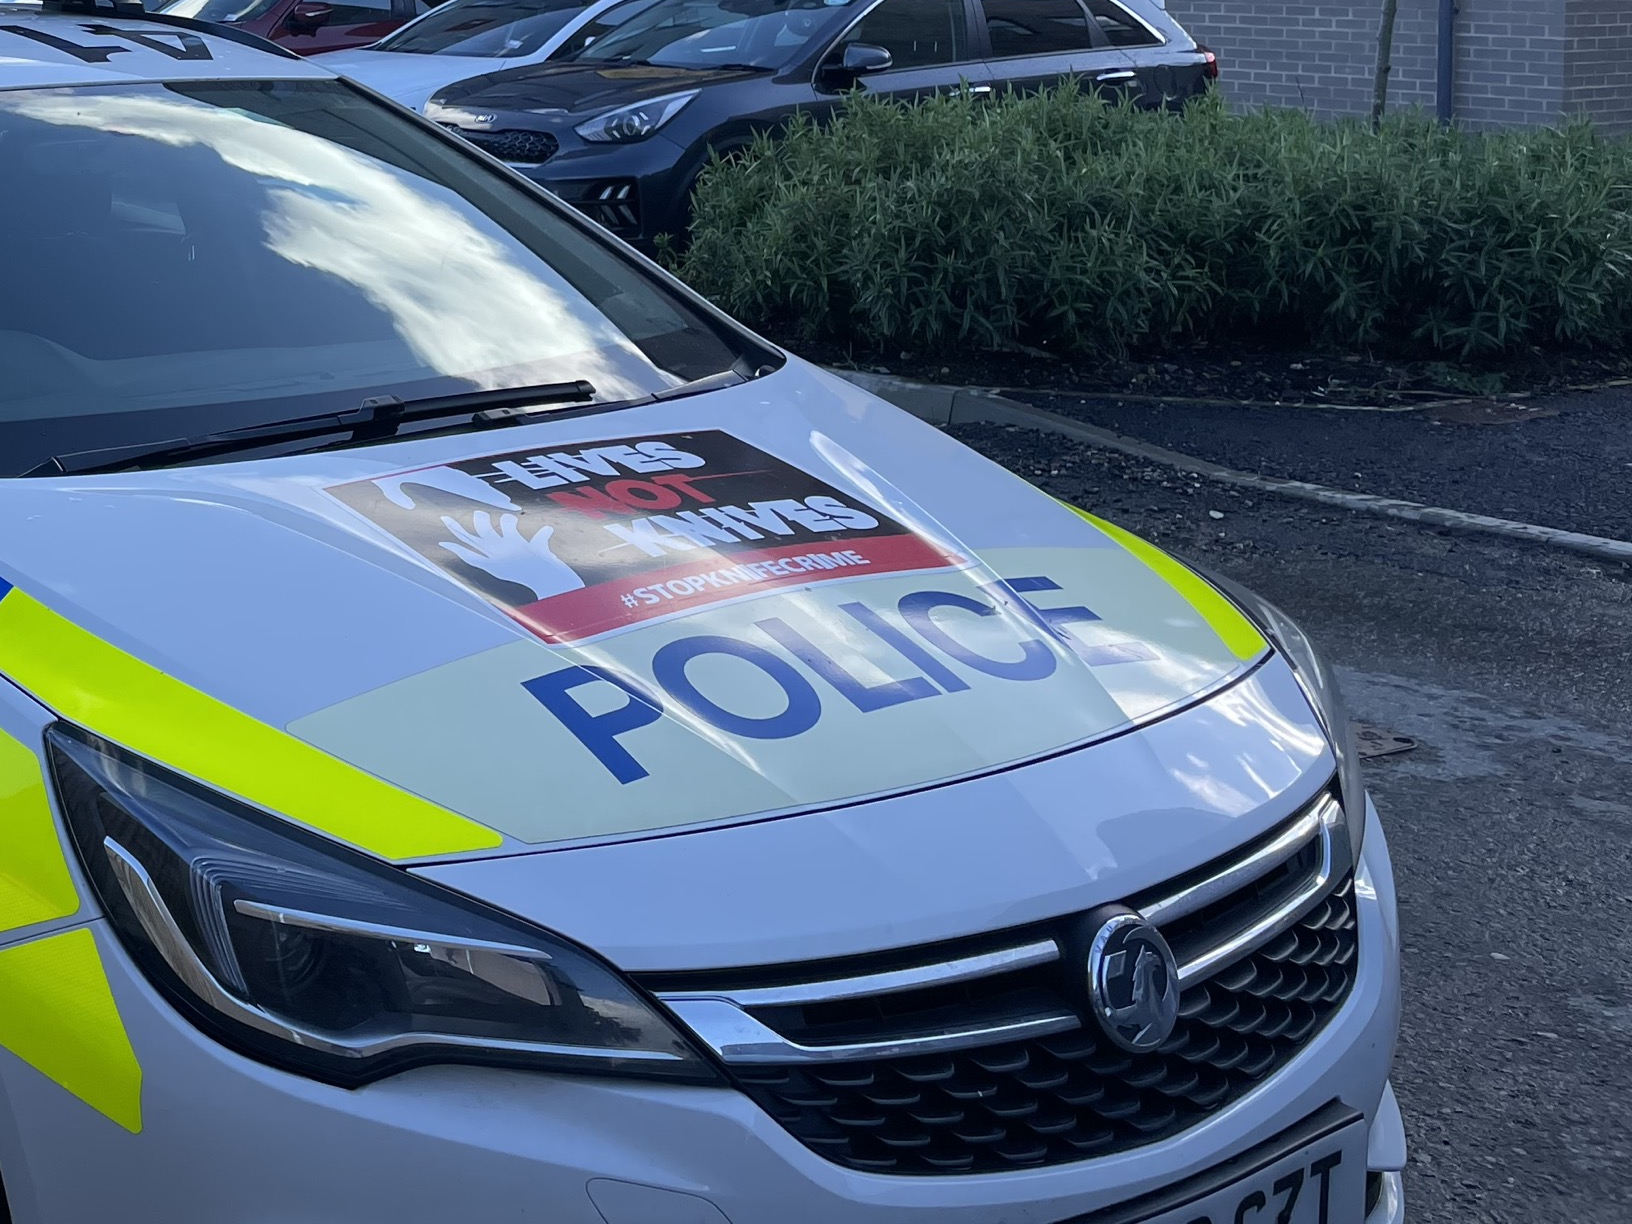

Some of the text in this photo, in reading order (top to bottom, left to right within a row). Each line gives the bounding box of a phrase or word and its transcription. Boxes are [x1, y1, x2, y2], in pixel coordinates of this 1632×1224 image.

[490, 441, 706, 490] LIVES
[546, 473, 717, 520] NOT
[602, 496, 880, 558] KNIVES
[620, 549, 871, 609] #STOPKNIFECRIME
[519, 575, 1160, 786] POLICE
